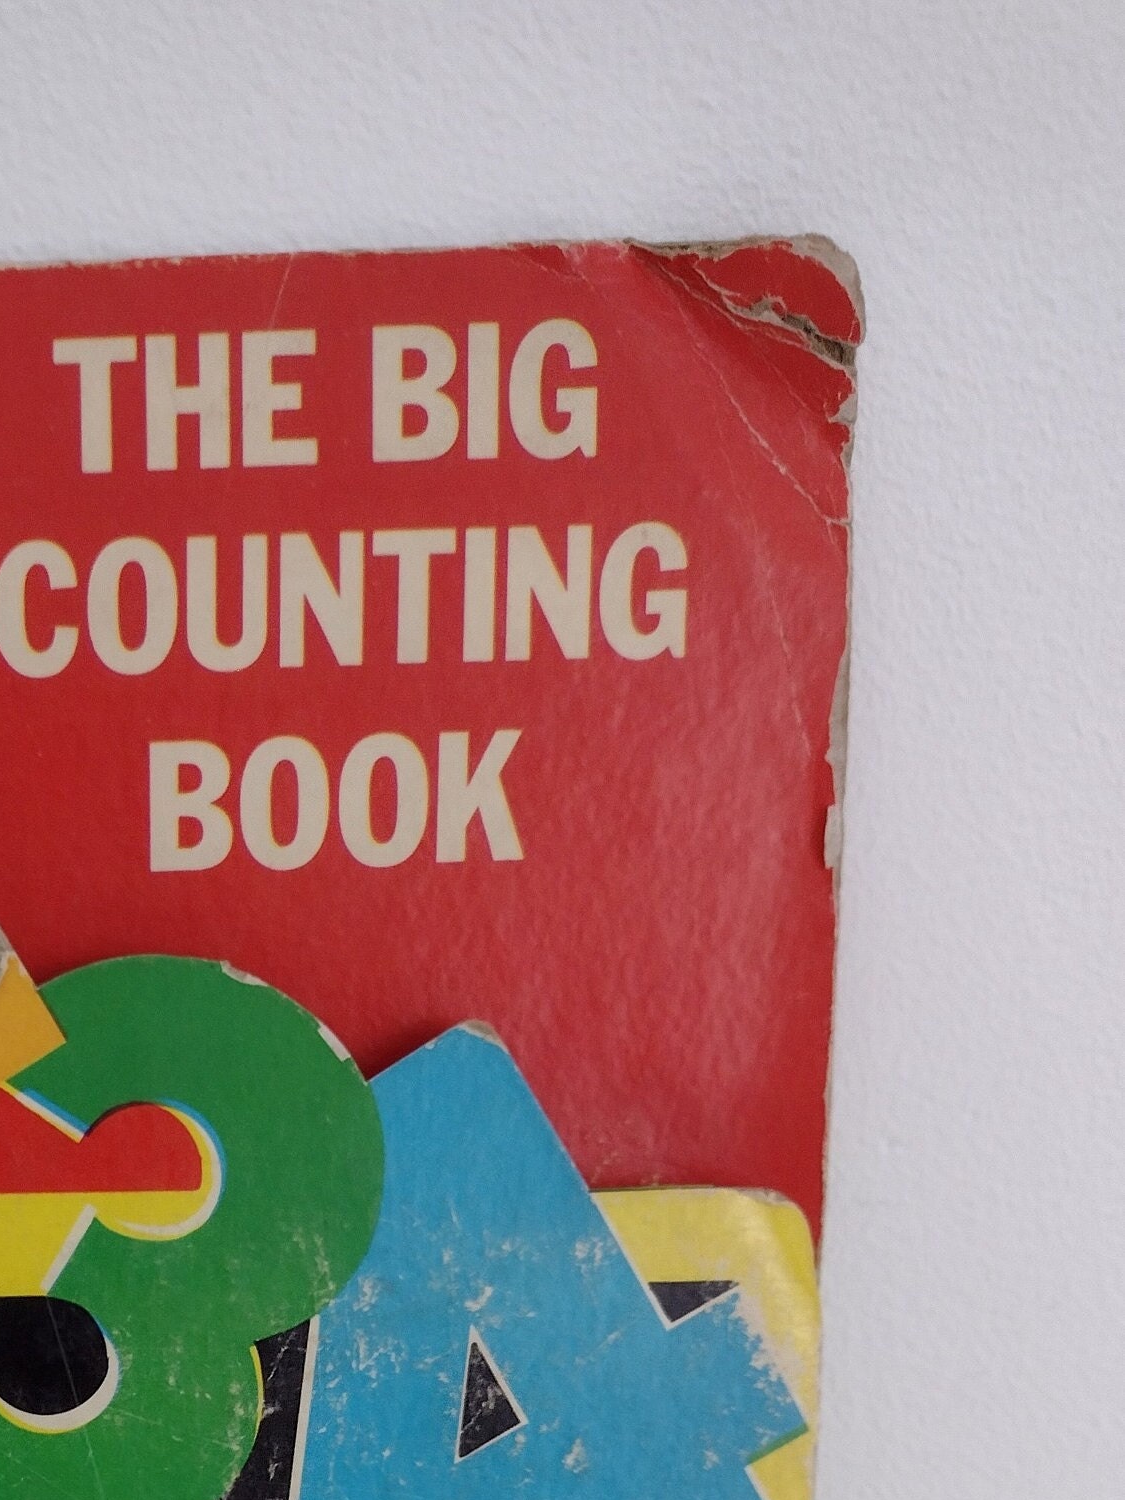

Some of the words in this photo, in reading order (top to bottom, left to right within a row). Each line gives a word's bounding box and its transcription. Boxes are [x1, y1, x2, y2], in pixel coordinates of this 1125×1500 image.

[52, 328, 319, 474] THE
[371, 318, 599, 463] BIG
[149, 728, 525, 874] BOOK
